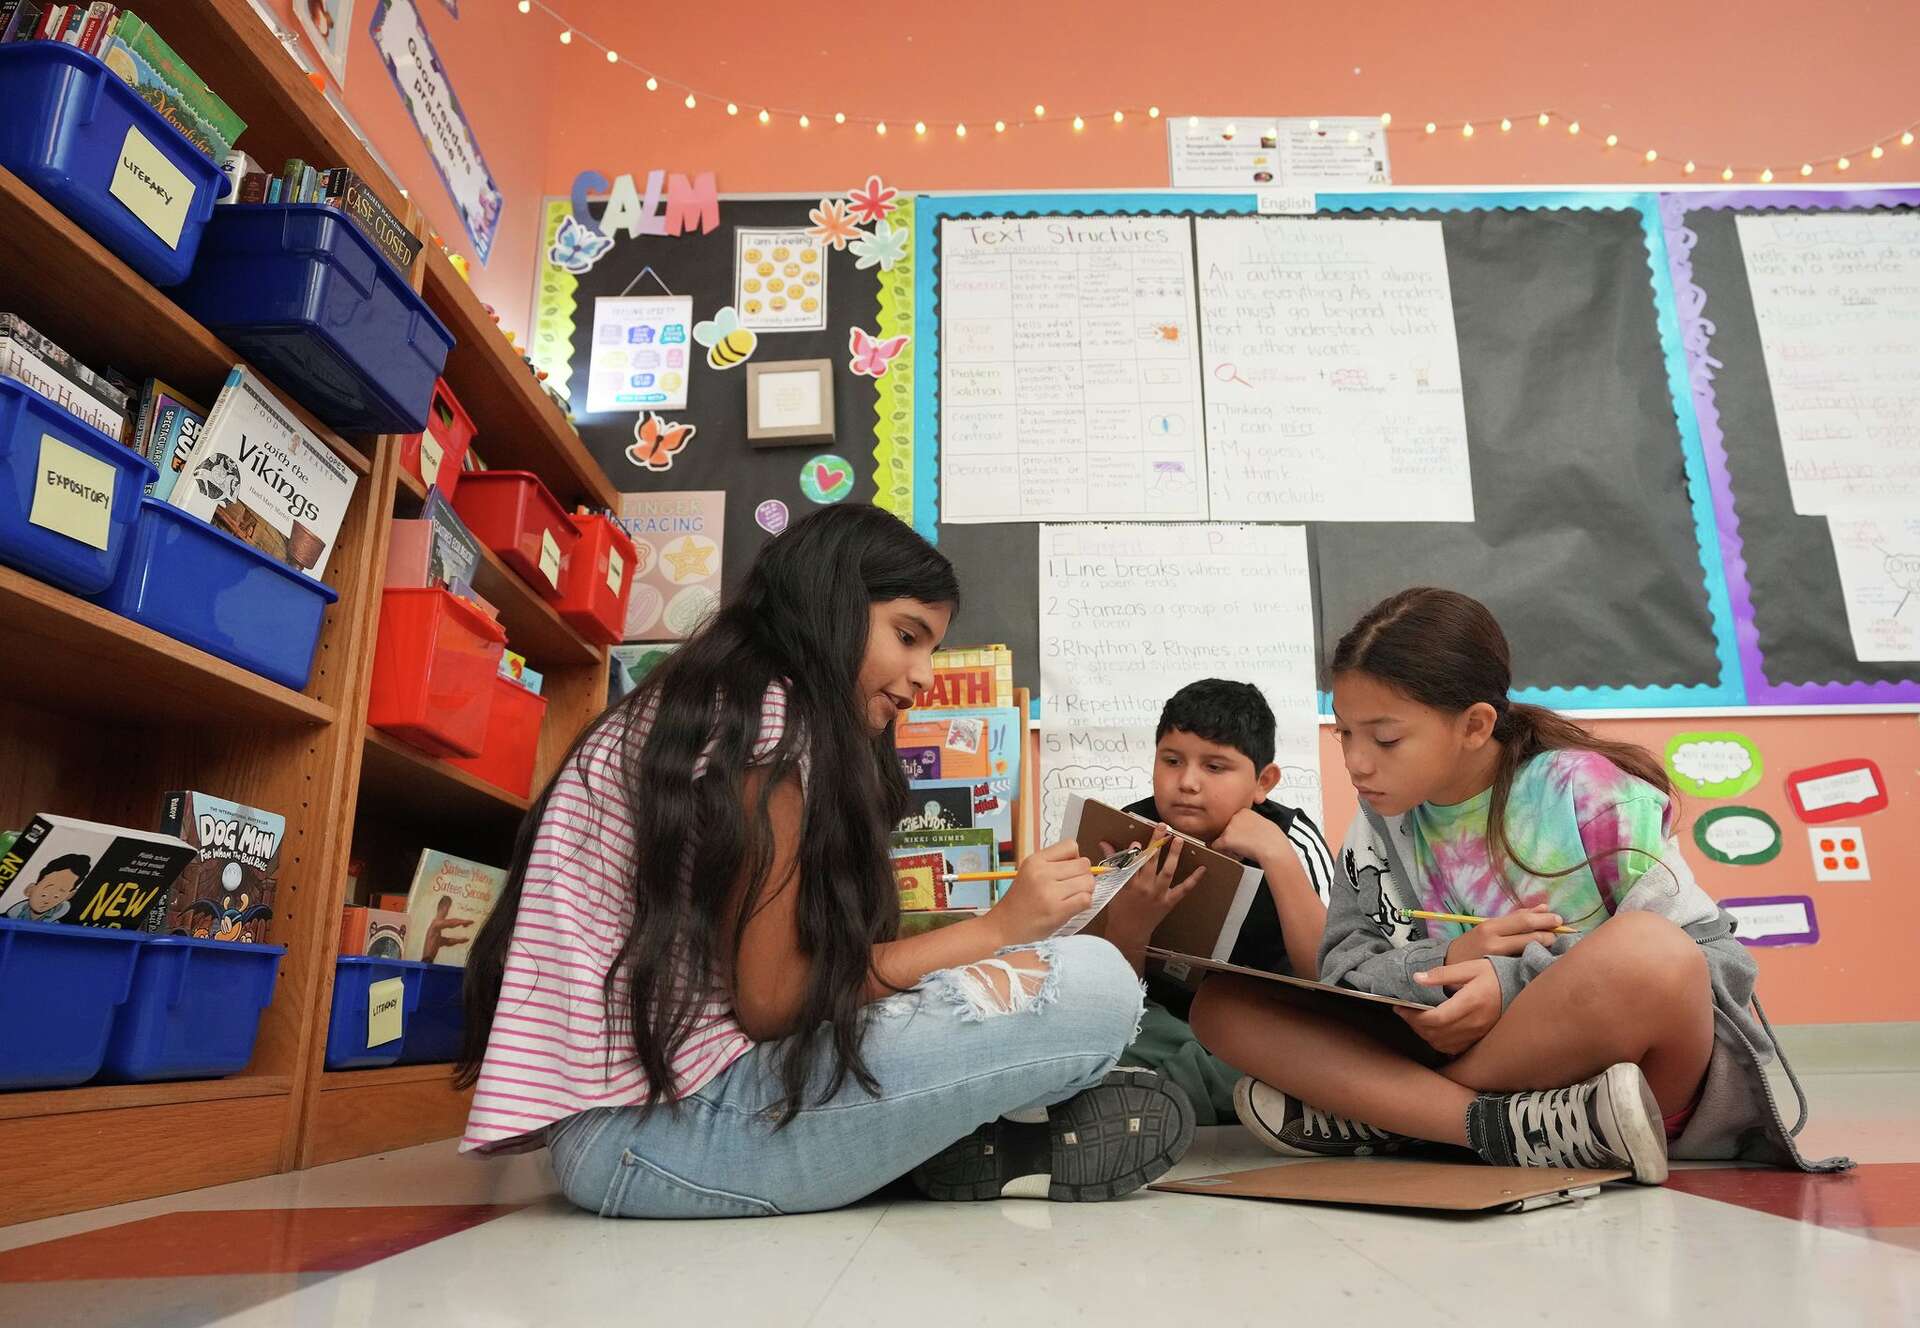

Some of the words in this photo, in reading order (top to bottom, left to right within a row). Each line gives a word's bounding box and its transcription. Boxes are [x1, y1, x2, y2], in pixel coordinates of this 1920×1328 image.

[407, 37, 436, 96] Good
[435, 99, 472, 175] readers
[414, 77, 458, 167] practice.
[570, 169, 720, 241] CALM
[1261, 196, 1312, 210] English
[346, 185, 375, 227] CASE
[374, 215, 413, 267] CLOSED
[962, 224, 1027, 245] Text
[1046, 223, 1169, 244] Structures
[1209, 263, 1234, 281] An
[1247, 265, 1304, 281] author
[1381, 266, 1432, 283] always
[1350, 284, 1371, 301] As
[1236, 302, 1276, 319] must
[1288, 305, 1310, 320] go
[1321, 301, 1384, 320] beyond
[1398, 301, 1430, 318] the
[1206, 319, 1243, 337] text
[1256, 319, 1279, 336] to
[1285, 319, 1375, 336] understand
[1207, 338, 1230, 354] the
[1240, 339, 1298, 356] author
[9, 349, 55, 400] Harry
[56, 383, 117, 439] Houdini
[153, 409, 176, 461] SPECTACULAR
[1240, 421, 1272, 434] can
[263, 441, 291, 469] with
[291, 463, 310, 485] the
[1241, 464, 1291, 481] think
[238, 433, 321, 522] Vikings
[46, 469, 110, 511] EXPOSITORY
[1246, 485, 1327, 505] conclude
[623, 516, 705, 533] TRACING
[1064, 560, 1108, 577] Line
[1115, 559, 1182, 578] breaks
[1187, 562, 1233, 577] where
[1241, 563, 1279, 577] each
[1099, 578, 1136, 591] poem
[1144, 576, 1178, 589] ends
[1067, 597, 1147, 619] Stanzas
[1169, 600, 1218, 622] group
[1223, 599, 1242, 615] of
[1062, 640, 1139, 662] Rhythm
[1142, 640, 1158, 657] &
[1087, 658, 1147, 673] stressed
[1065, 693, 1163, 717] Repetition
[1045, 732, 1062, 753] 5
[1068, 732, 1130, 753] Mood
[1055, 771, 1136, 791] Imagery
[200, 813, 239, 851] DOG
[239, 824, 276, 860] MAN
[903, 836, 929, 844] NIKKI
[932, 834, 965, 842] GRIMES
[79, 881, 161, 921] NEW
